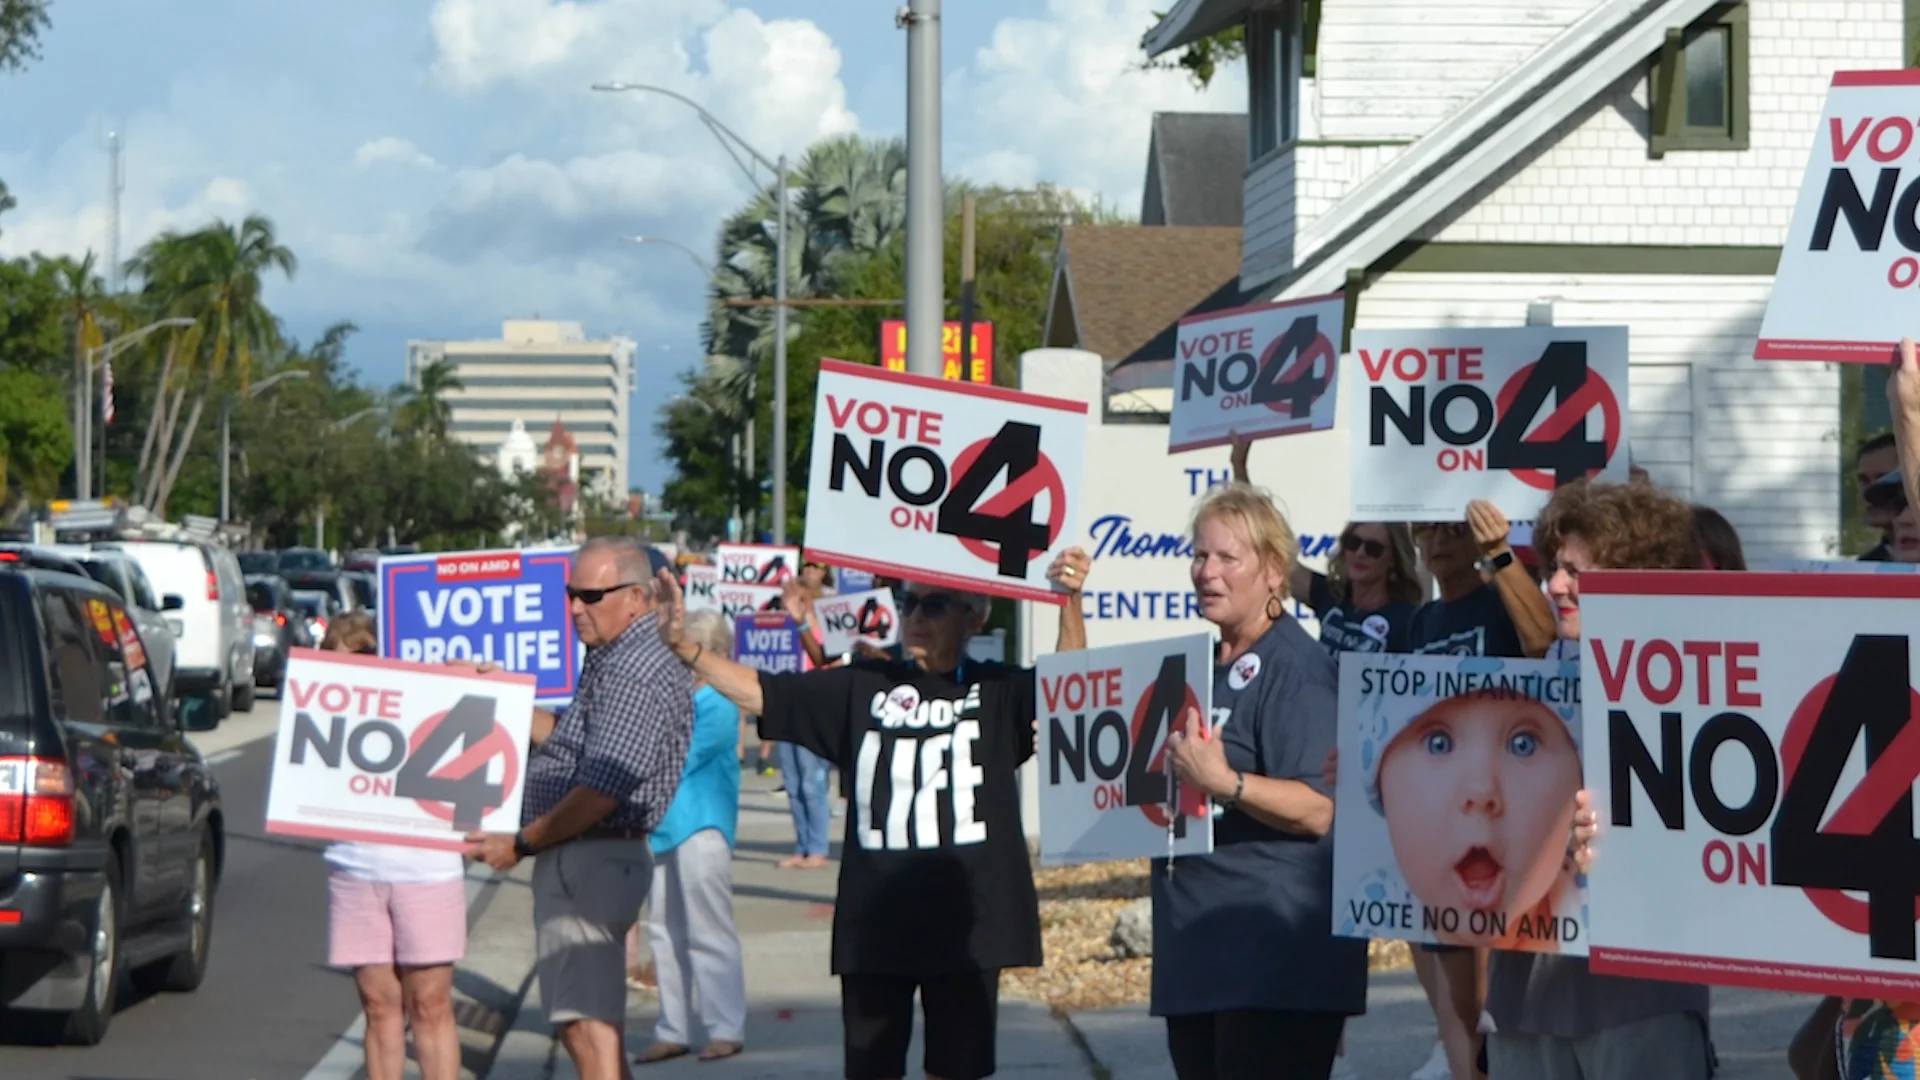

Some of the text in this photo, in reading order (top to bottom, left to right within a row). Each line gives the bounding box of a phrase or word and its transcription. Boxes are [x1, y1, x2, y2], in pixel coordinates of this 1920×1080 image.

[1829, 116, 1920, 162] VO
[1887, 257, 1920, 289] O
[1179, 327, 1254, 360] VOTE
[1358, 347, 1483, 382] VOTE
[1181, 351, 1257, 402] NO
[1219, 314, 1327, 420] ON 4
[825, 394, 943, 445] VOTE
[1369, 384, 1494, 446] NO
[1436, 341, 1606, 488] ON 4
[829, 432, 948, 506] NO
[1184, 468, 1230, 496] TH
[890, 420, 1051, 579] ON 4
[1089, 514, 1195, 560] Thom
[437, 558, 521, 575] NO ON AMD 4
[724, 564, 758, 582] NO
[417, 583, 543, 628] VOTE
[825, 612, 857, 633] NO
[859, 597, 891, 639] 4
[400, 630, 561, 671] PRO-LIFE
[745, 629, 793, 651] VOTE
[1041, 668, 1123, 713] VOTE
[1361, 668, 1581, 704] STOP INFANTICI
[1589, 638, 1763, 707] VOTE
[288, 678, 404, 719] VOTE
[289, 711, 407, 774] NO
[349, 694, 504, 833] ON 4
[1049, 709, 1130, 786] NO
[1093, 653, 1187, 838] ON 4
[855, 719, 988, 850] LIFE
[1607, 709, 1779, 837] NO
[1702, 634, 1920, 961] ON 4
[1350, 899, 1579, 943] VOTE NO ON AMD
